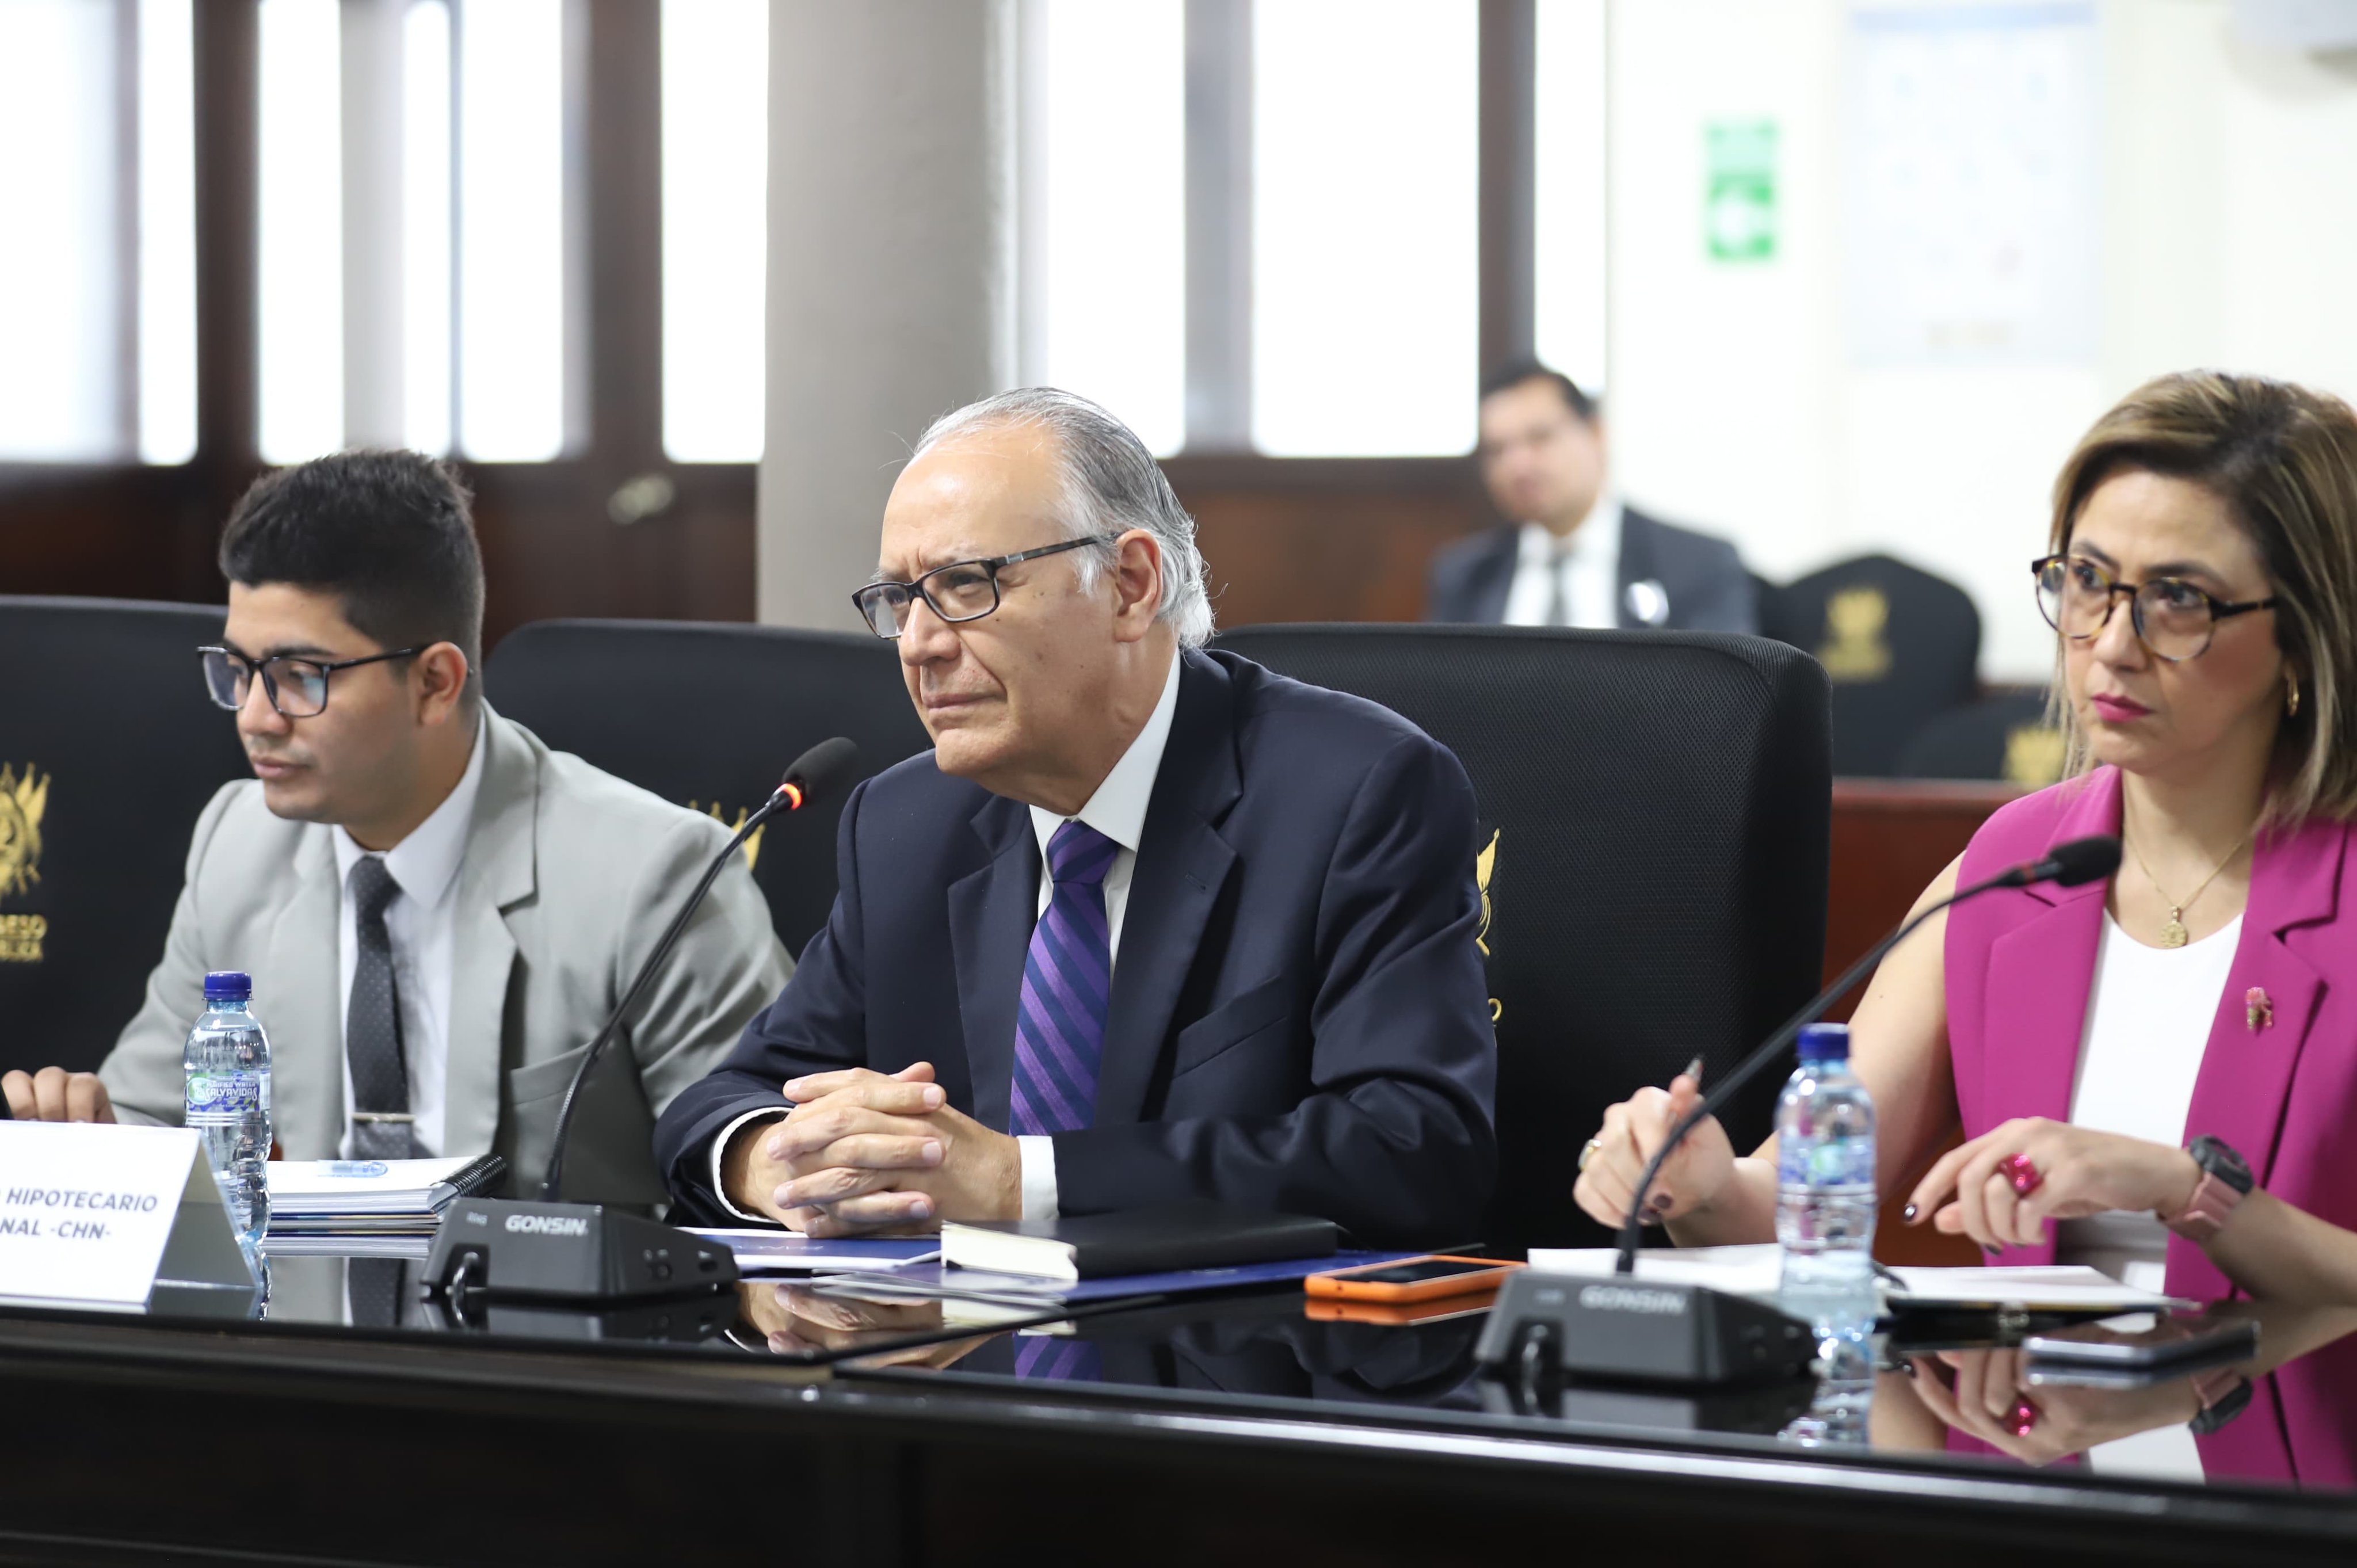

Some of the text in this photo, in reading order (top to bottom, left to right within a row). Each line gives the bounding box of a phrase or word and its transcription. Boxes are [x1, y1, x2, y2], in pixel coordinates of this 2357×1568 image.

[205, 1087, 258, 1101] SALVAVIDAS
[6, 1187, 158, 1212] HIPOTECARIO
[50, 1220, 111, 1239] -CHN-
[505, 1214, 587, 1237] GONSIN
